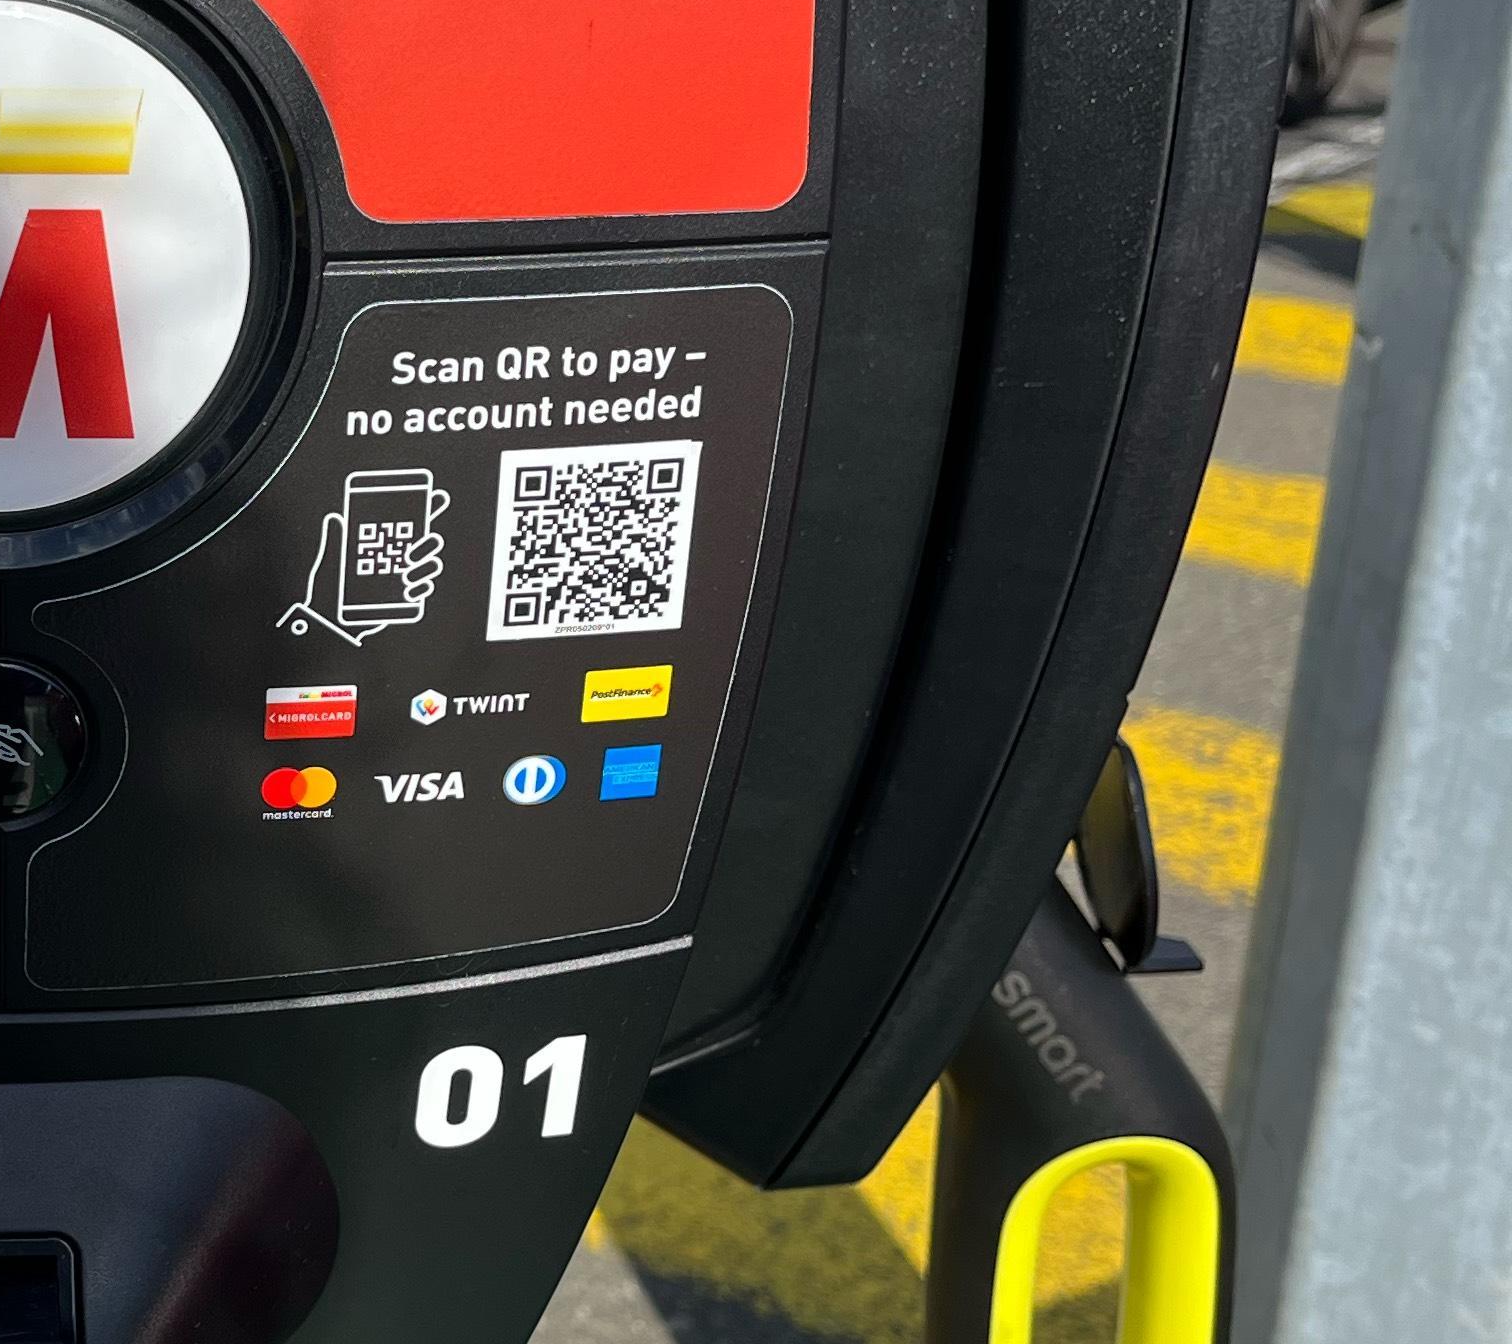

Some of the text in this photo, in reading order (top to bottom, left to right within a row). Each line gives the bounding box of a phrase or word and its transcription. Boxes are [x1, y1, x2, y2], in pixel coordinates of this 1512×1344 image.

[391, 351, 485, 385] Scan
[496, 346, 551, 381] QR
[561, 346, 598, 377] to
[608, 346, 677, 383] pay
[345, 385, 703, 436] no account needed
[590, 687, 652, 700] PostFinance
[373, 771, 465, 803] VISA
[991, 970, 1106, 1104] smart
[415, 1034, 587, 1148] 01
